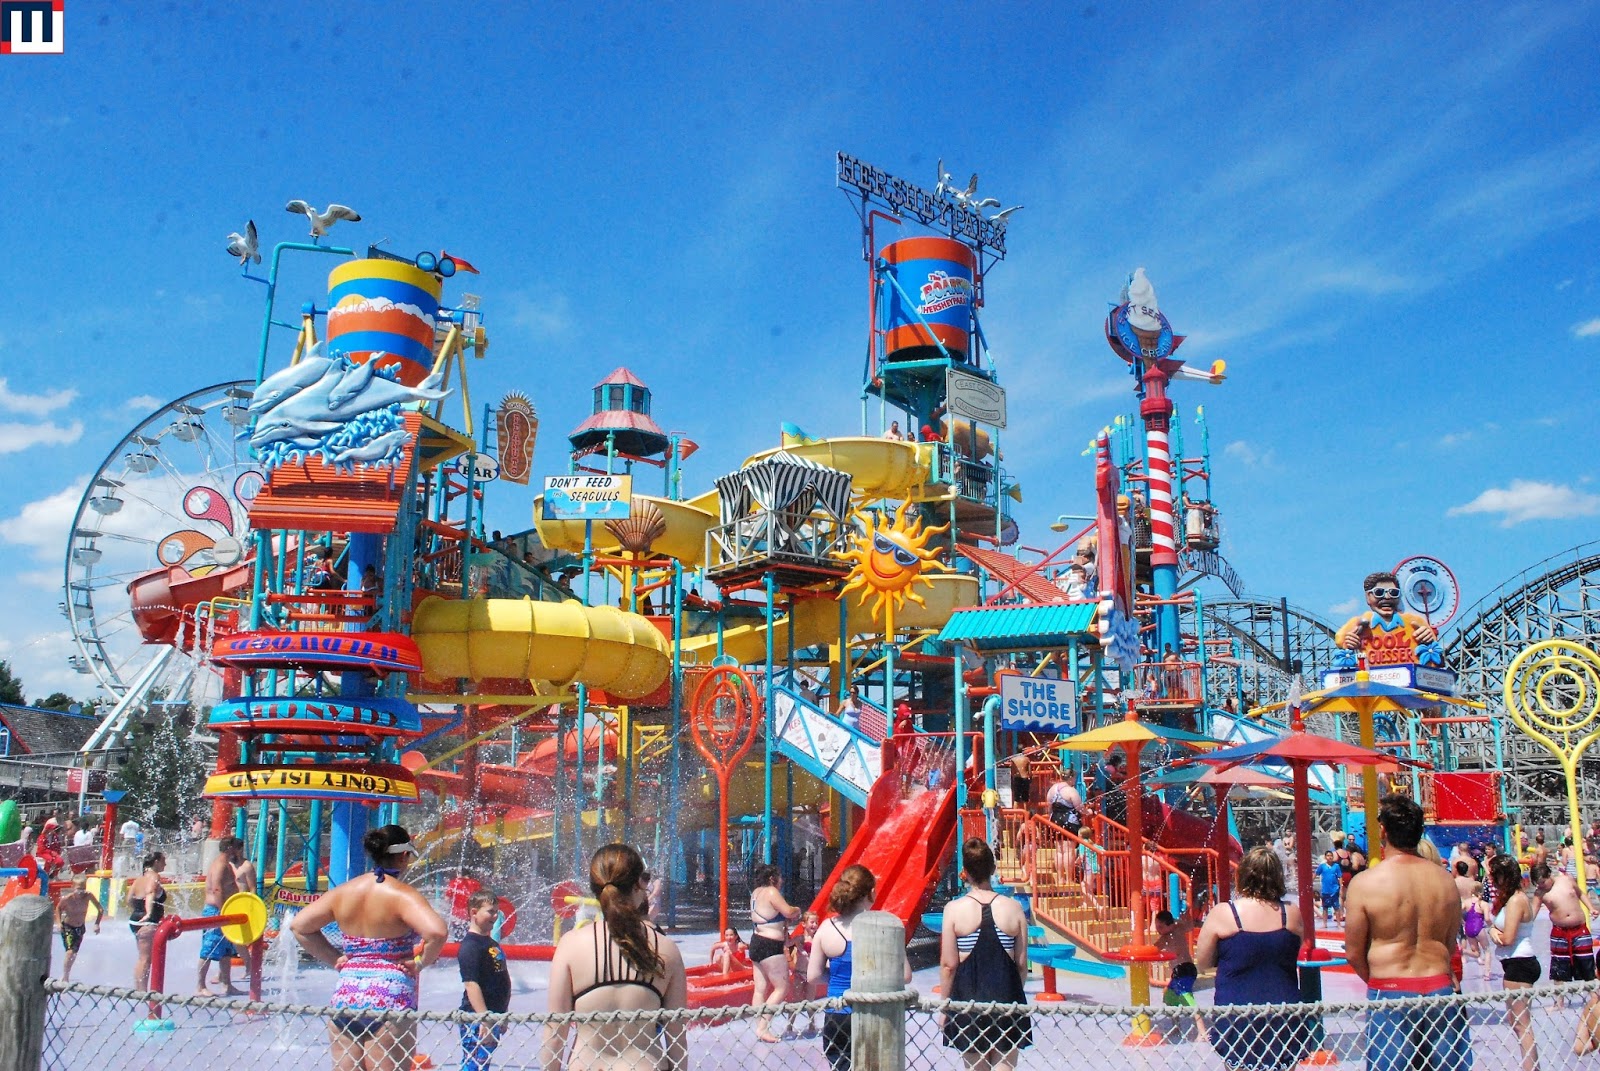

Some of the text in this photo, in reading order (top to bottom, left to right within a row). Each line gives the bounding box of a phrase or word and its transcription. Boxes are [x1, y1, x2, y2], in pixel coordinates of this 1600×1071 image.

[838, 152, 1006, 252] HERSHEYPARK
[1121, 331, 1172, 357] ICE CREAM
[510, 414, 520, 476] PEANUTS
[550, 477, 612, 488] DON'T FEED
[570, 491, 620, 501] SEAGULLS
[230, 636, 398, 661] WILDWOOD
[1368, 648, 1414, 664] GUESSER
[1020, 681, 1056, 701] THE
[232, 703, 398, 727] OCEAN CITY
[1008, 698, 1070, 720] SHORE
[229, 770, 390, 794] CONEY ISLAND
[279, 890, 321, 903] CAUTIO
